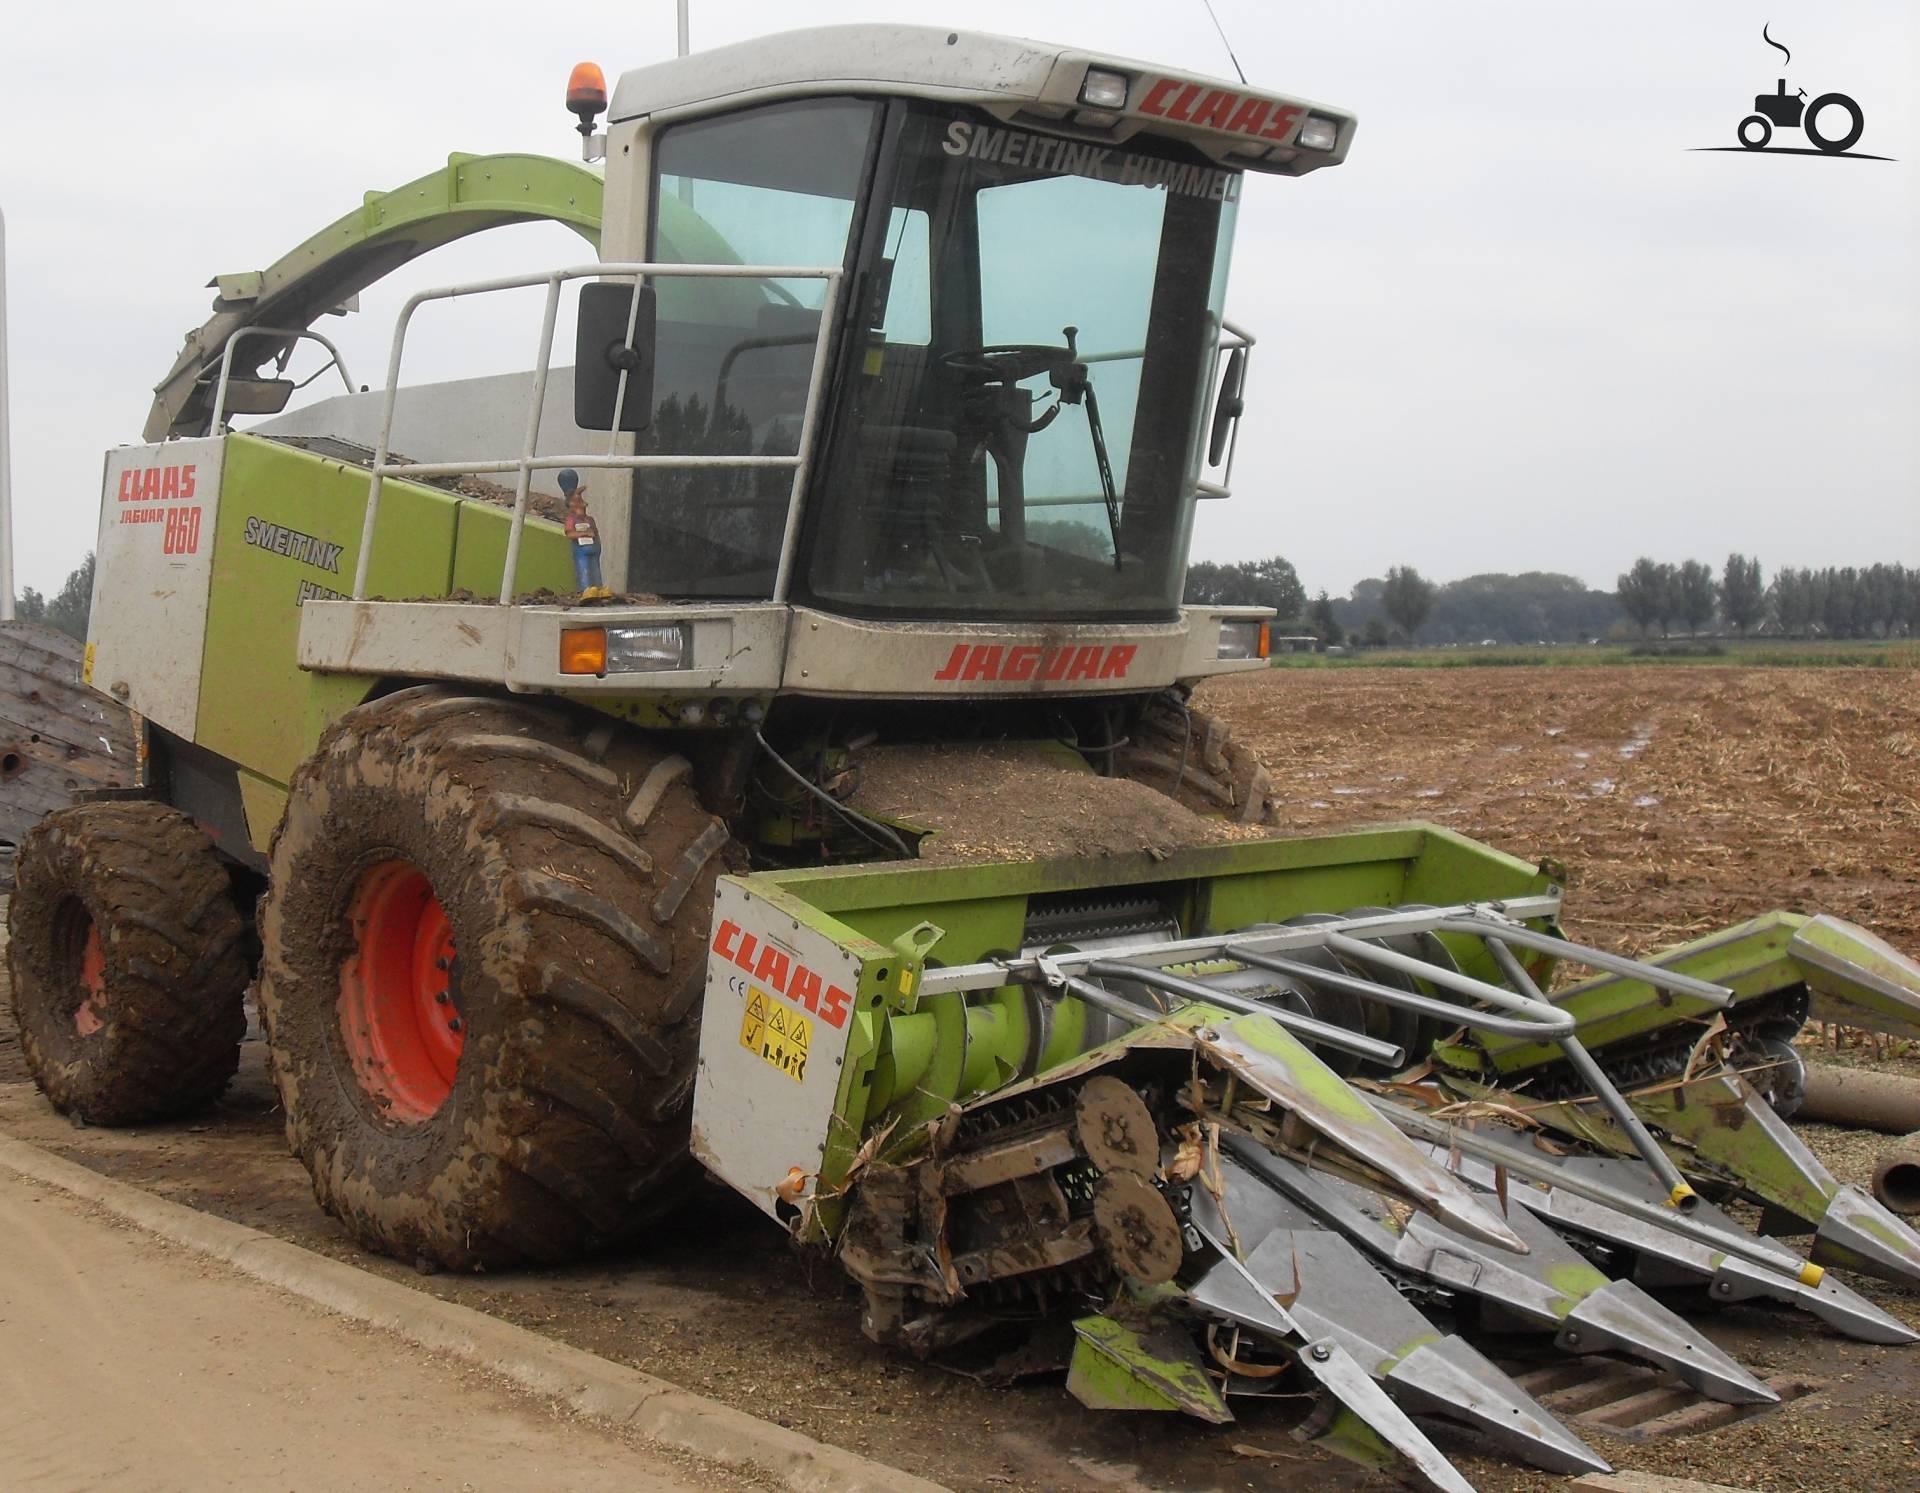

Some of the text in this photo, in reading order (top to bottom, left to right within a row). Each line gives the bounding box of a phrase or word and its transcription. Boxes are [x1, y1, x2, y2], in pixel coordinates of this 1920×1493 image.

[1138, 78, 1304, 140] CLAAS
[942, 121, 1238, 202] SMEITINK HUMMEL
[118, 464, 197, 502] CLAAS
[119, 506, 202, 555] JAGUAR 860
[245, 515, 345, 574] SMEITINK
[934, 644, 1138, 681] JAGUAR
[712, 919, 853, 1030] CLAAS
